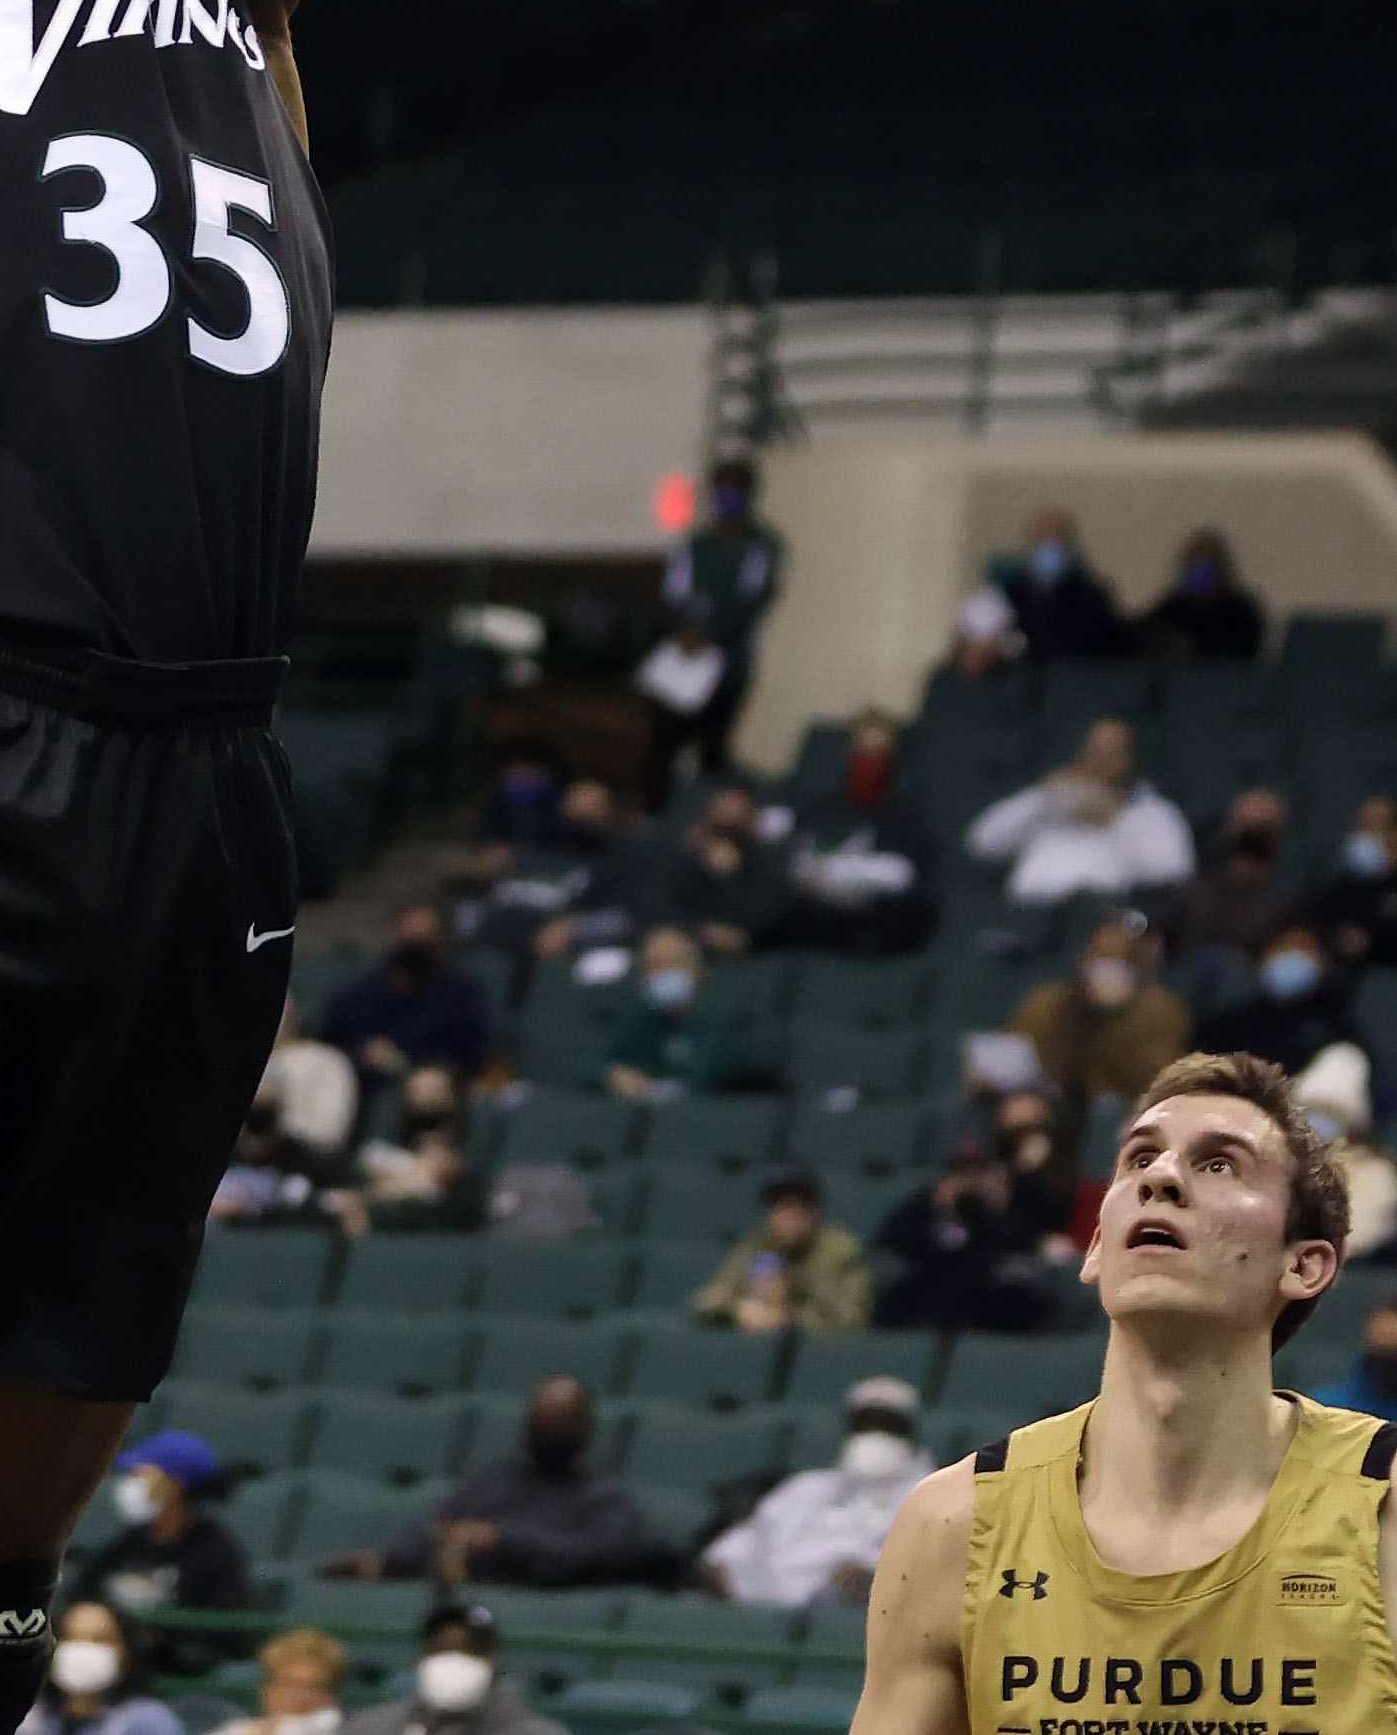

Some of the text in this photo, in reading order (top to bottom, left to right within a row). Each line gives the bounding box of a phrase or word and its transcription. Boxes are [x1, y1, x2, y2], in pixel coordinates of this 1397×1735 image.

[40, 132, 291, 378] 35
[1281, 1582, 1337, 1593] HORIZON
[1001, 1655, 1317, 1706] PURDUE
[1039, 1718, 1268, 1735] FORT WAYNE
